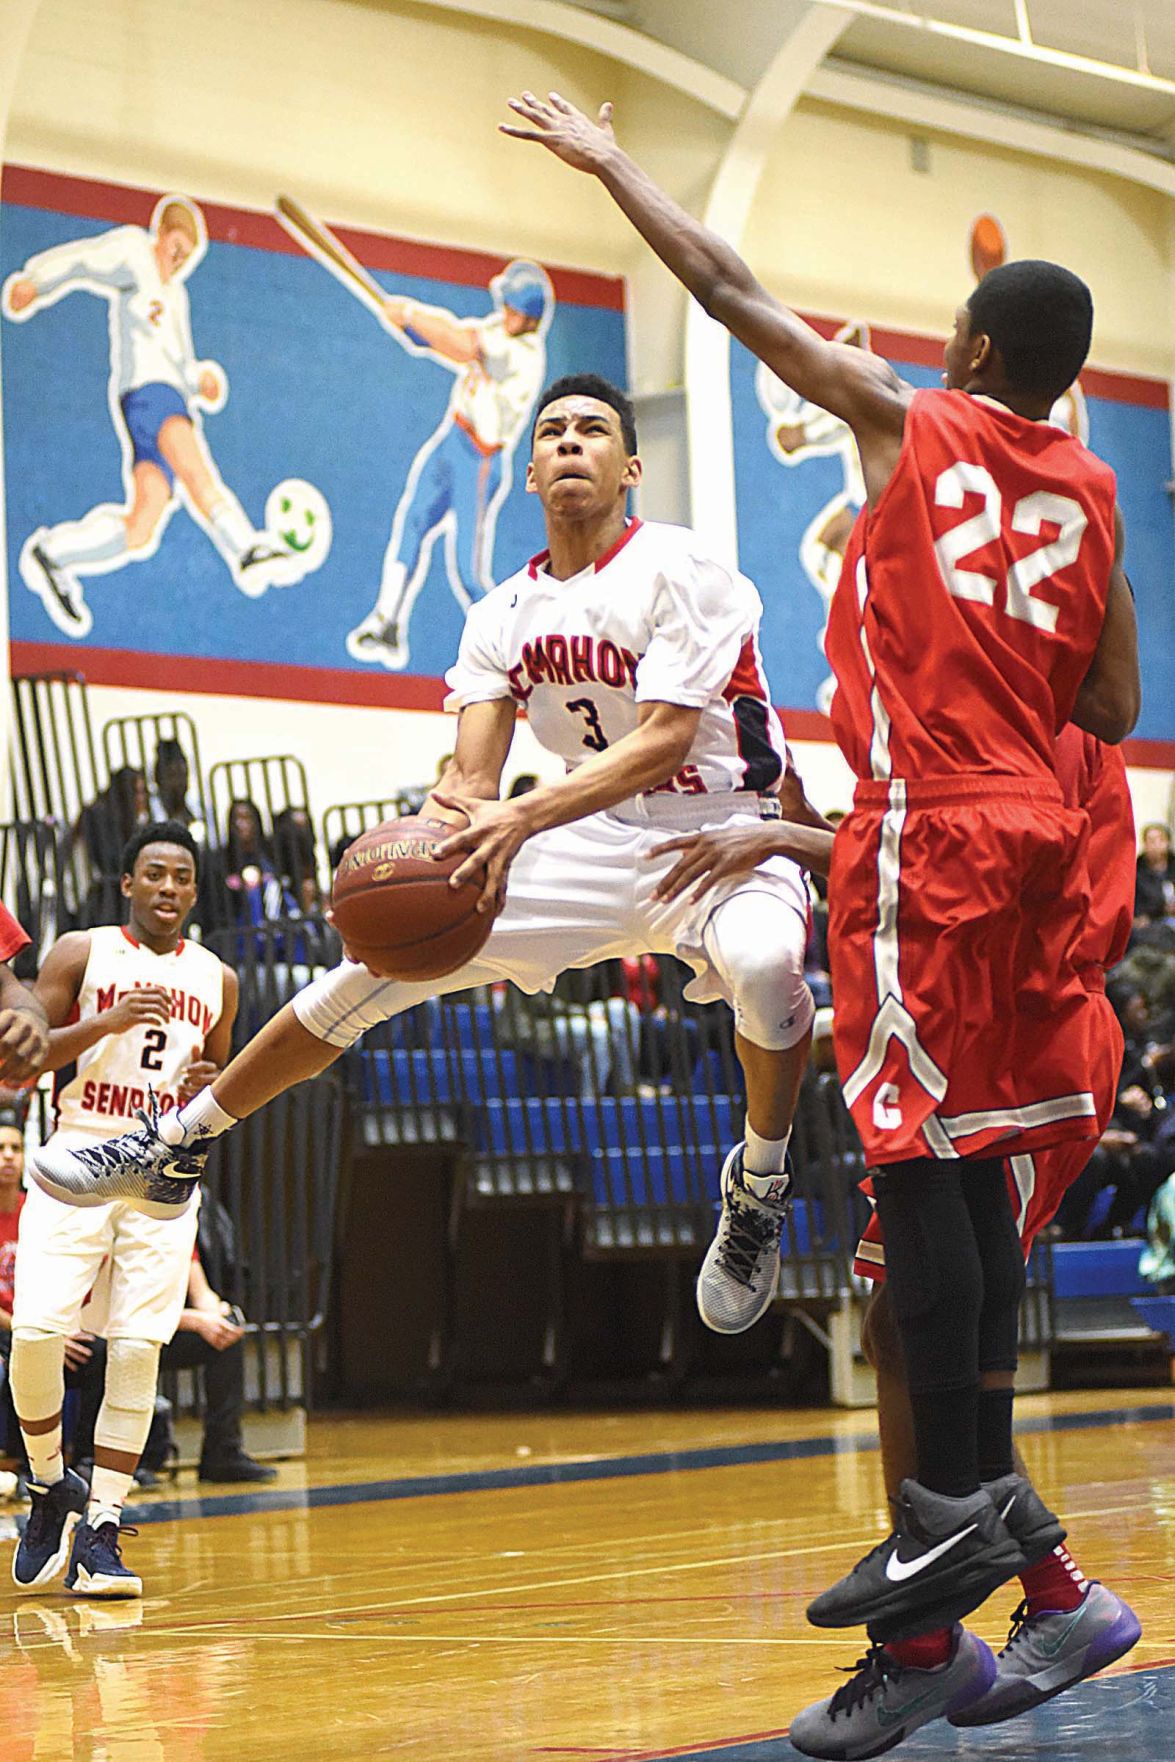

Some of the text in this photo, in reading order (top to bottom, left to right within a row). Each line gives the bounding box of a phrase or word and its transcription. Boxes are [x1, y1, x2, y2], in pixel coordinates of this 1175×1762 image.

[934, 461, 1089, 634] 22
[566, 698, 609, 752] 3
[140, 1029, 168, 1071] 2
